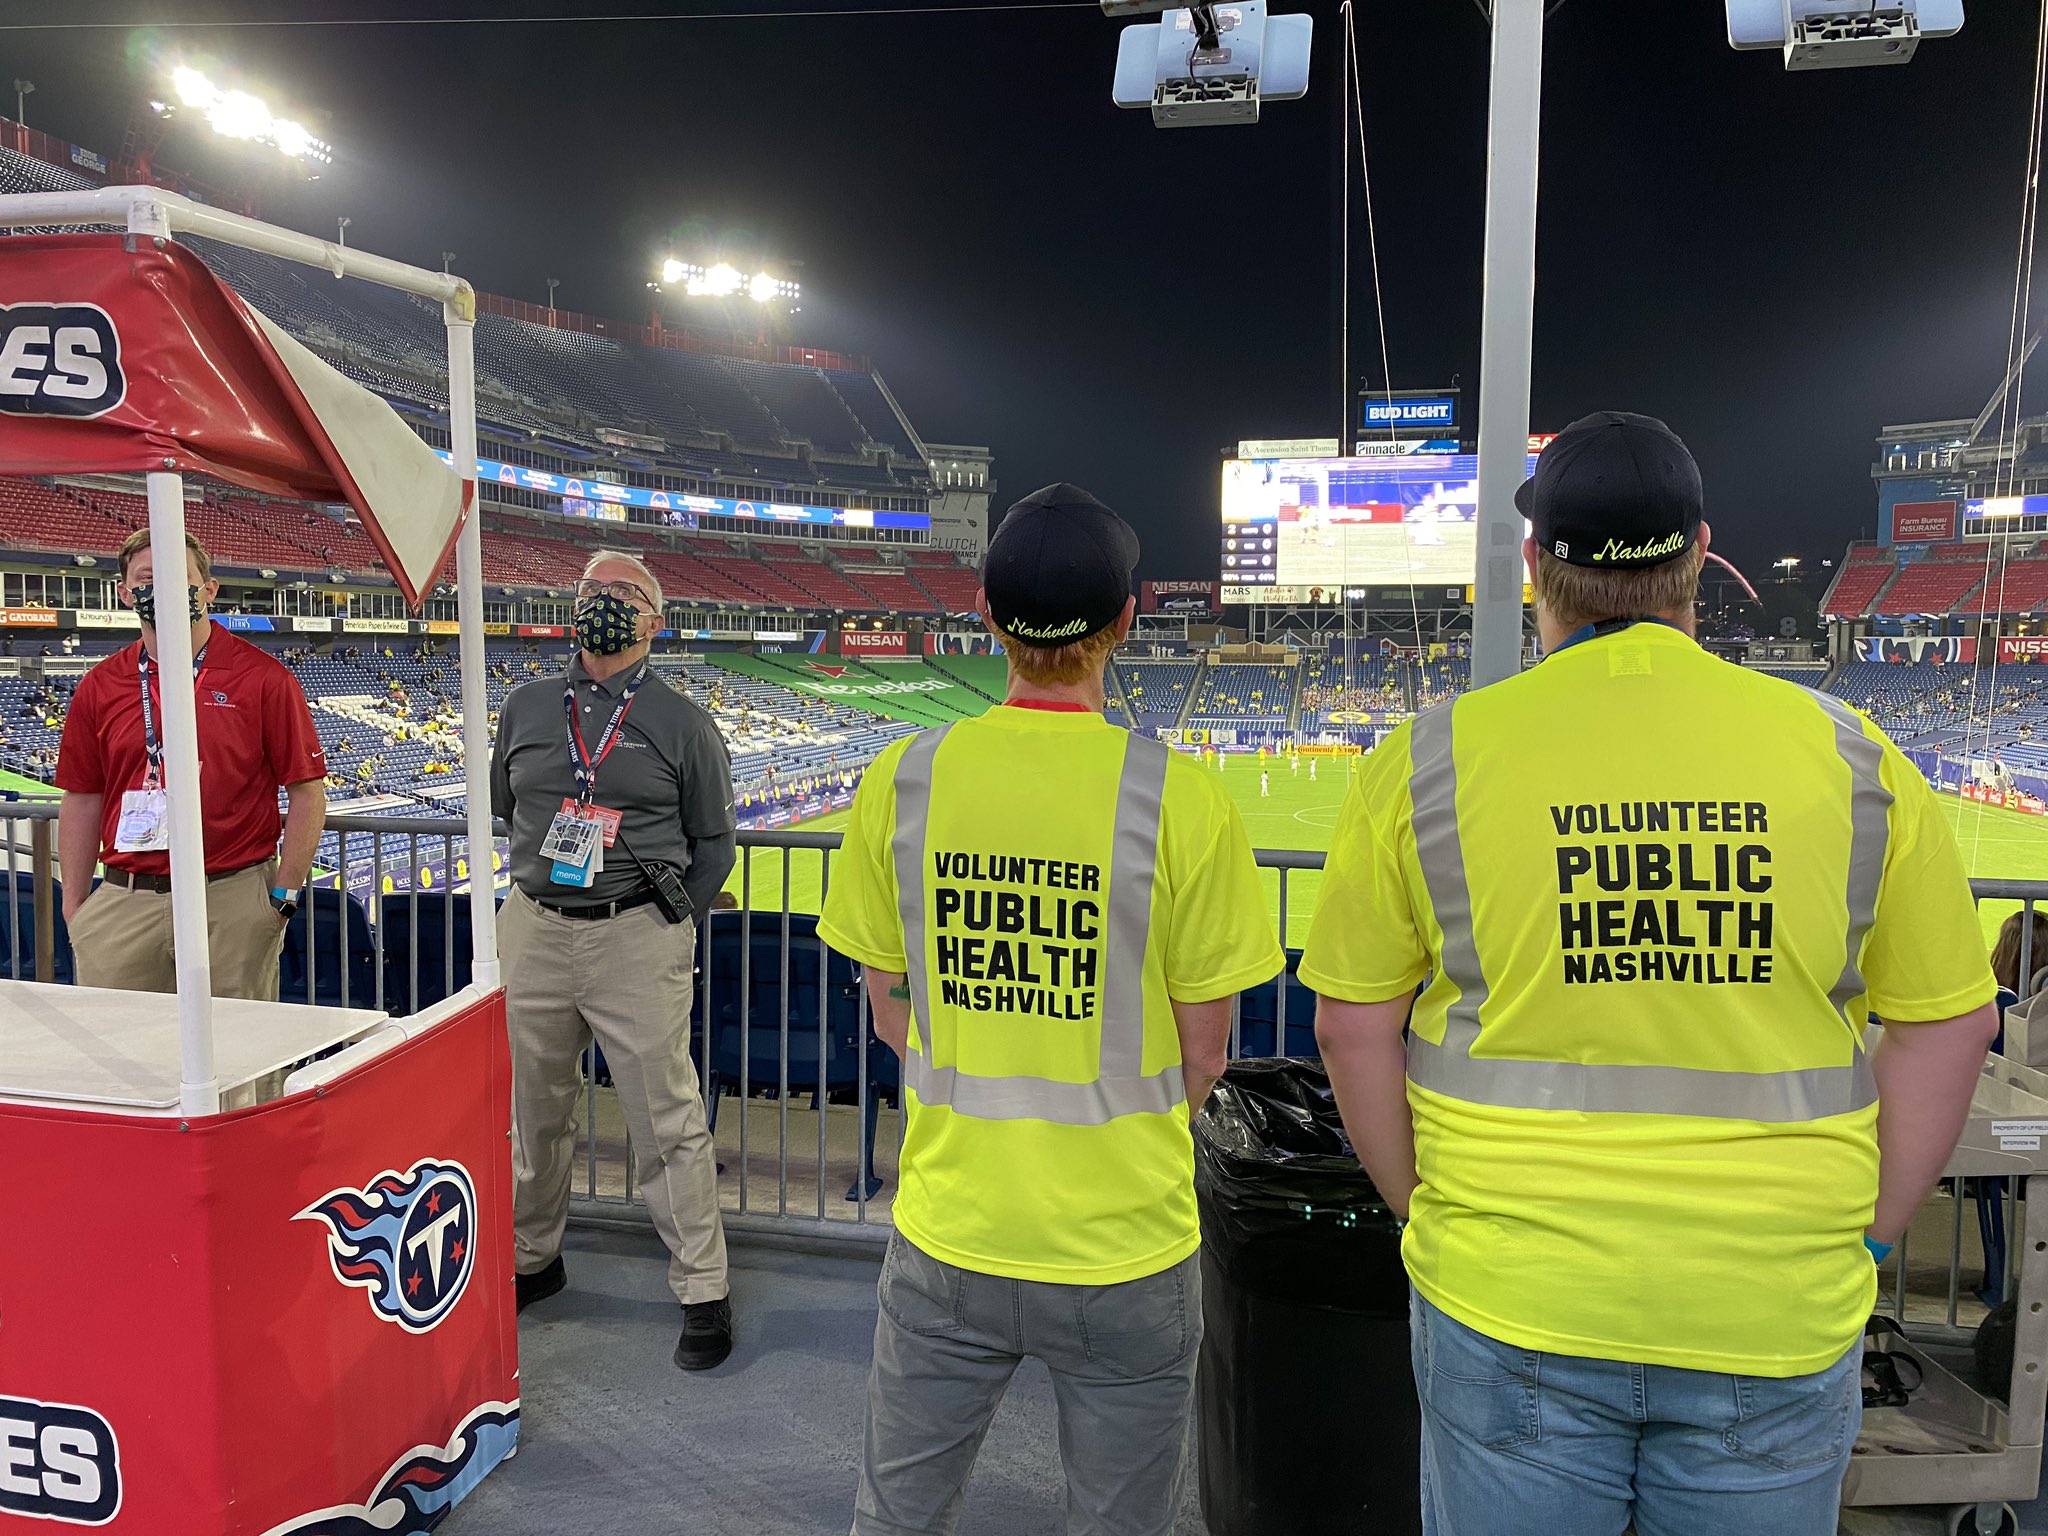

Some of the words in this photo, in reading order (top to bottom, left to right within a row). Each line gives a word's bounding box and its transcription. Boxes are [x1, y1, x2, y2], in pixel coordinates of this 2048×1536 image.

[80, 147, 98, 162] EDDIE
[71, 153, 106, 175] GEORGE
[1369, 407, 1401, 420] BUD
[1403, 405, 1450, 419] LIGHT
[1254, 446, 1290, 454] Ascension
[1290, 446, 1309, 454] Saint
[1310, 445, 1339, 454] Thomas
[1358, 443, 1406, 455] Pinnacle
[1228, 524, 1237, 534] 2
[1899, 524, 1947, 533] INSURANCE
[930, 537, 977, 550] CLUTCH
[1592, 530, 1685, 561] Nashville
[1152, 582, 1211, 592] NISSAN
[1223, 587, 1250, 595] MARS
[9, 612, 56, 623] GATORADE
[345, 621, 367, 629] American
[368, 621, 382, 630] Paper
[1007, 616, 1088, 639] Nashville
[844, 635, 903, 646] NISSAN
[1151, 646, 1175, 658] lite
[795, 678, 954, 696] Heneken
[596, 724, 615, 754] TENNESSEE
[609, 705, 624, 724] TITANS
[1297, 745, 1336, 757] Continenta
[1550, 801, 1768, 836] VOLUNTEER
[556, 870, 582, 881] memo
[935, 852, 1100, 892] VOLUNTEER
[1556, 843, 1772, 894] PUBLIC
[346, 875, 371, 889] JACKSON
[936, 888, 1099, 940] PUBLIC
[1559, 899, 1773, 949] HEALTH
[937, 935, 1097, 988] HEALTH
[1564, 951, 1773, 984] NASHVILLE
[942, 979, 1095, 1020] NASHVILLE
